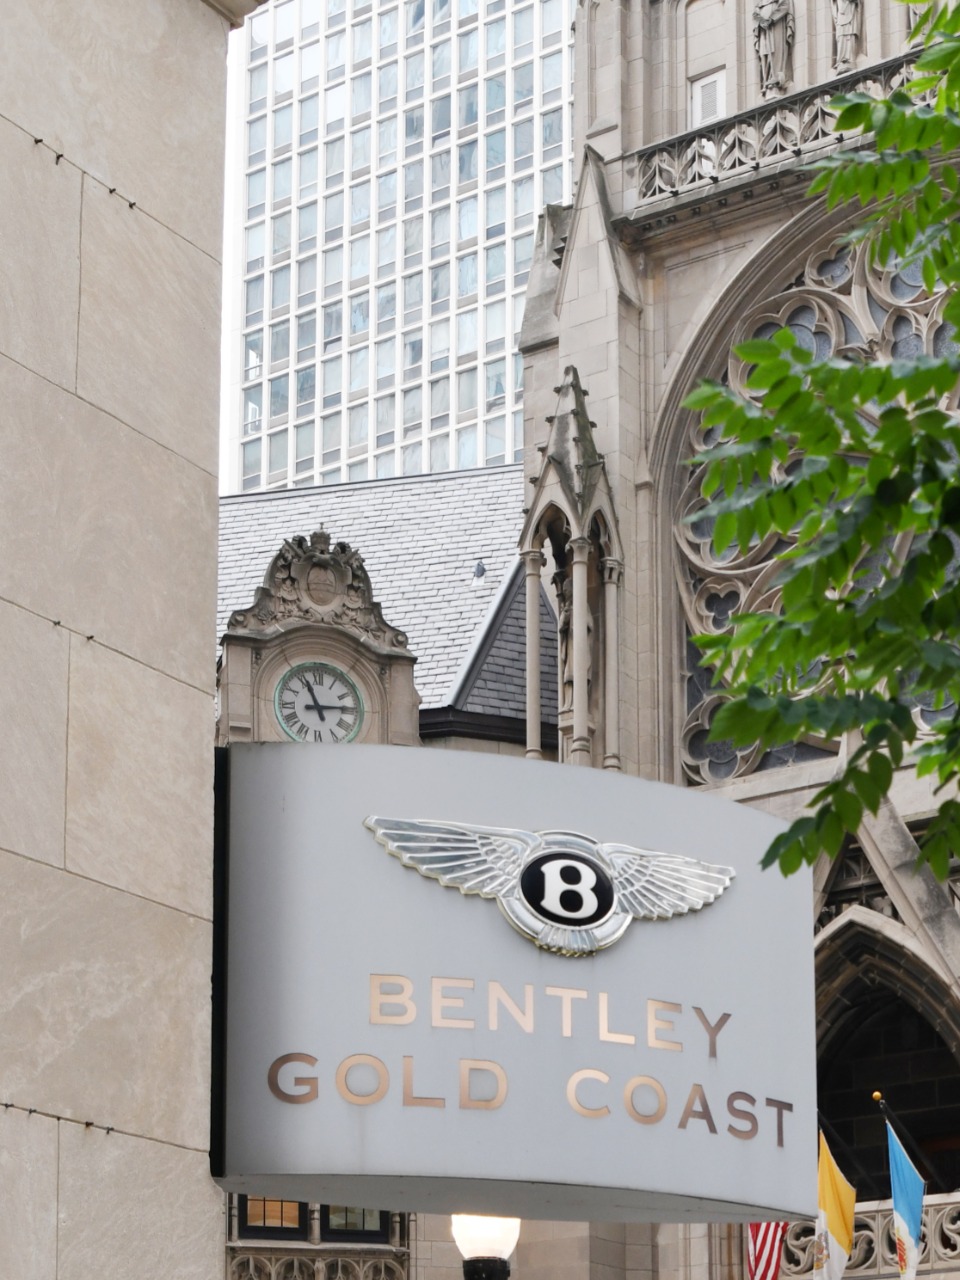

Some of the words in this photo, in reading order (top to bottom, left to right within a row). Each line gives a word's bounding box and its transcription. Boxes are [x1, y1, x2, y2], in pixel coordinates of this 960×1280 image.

[540, 857, 598, 920] B
[368, 973, 732, 1060] BENTLEY
[267, 1052, 509, 1111] GOLD
[566, 1068, 794, 1148] COAST
